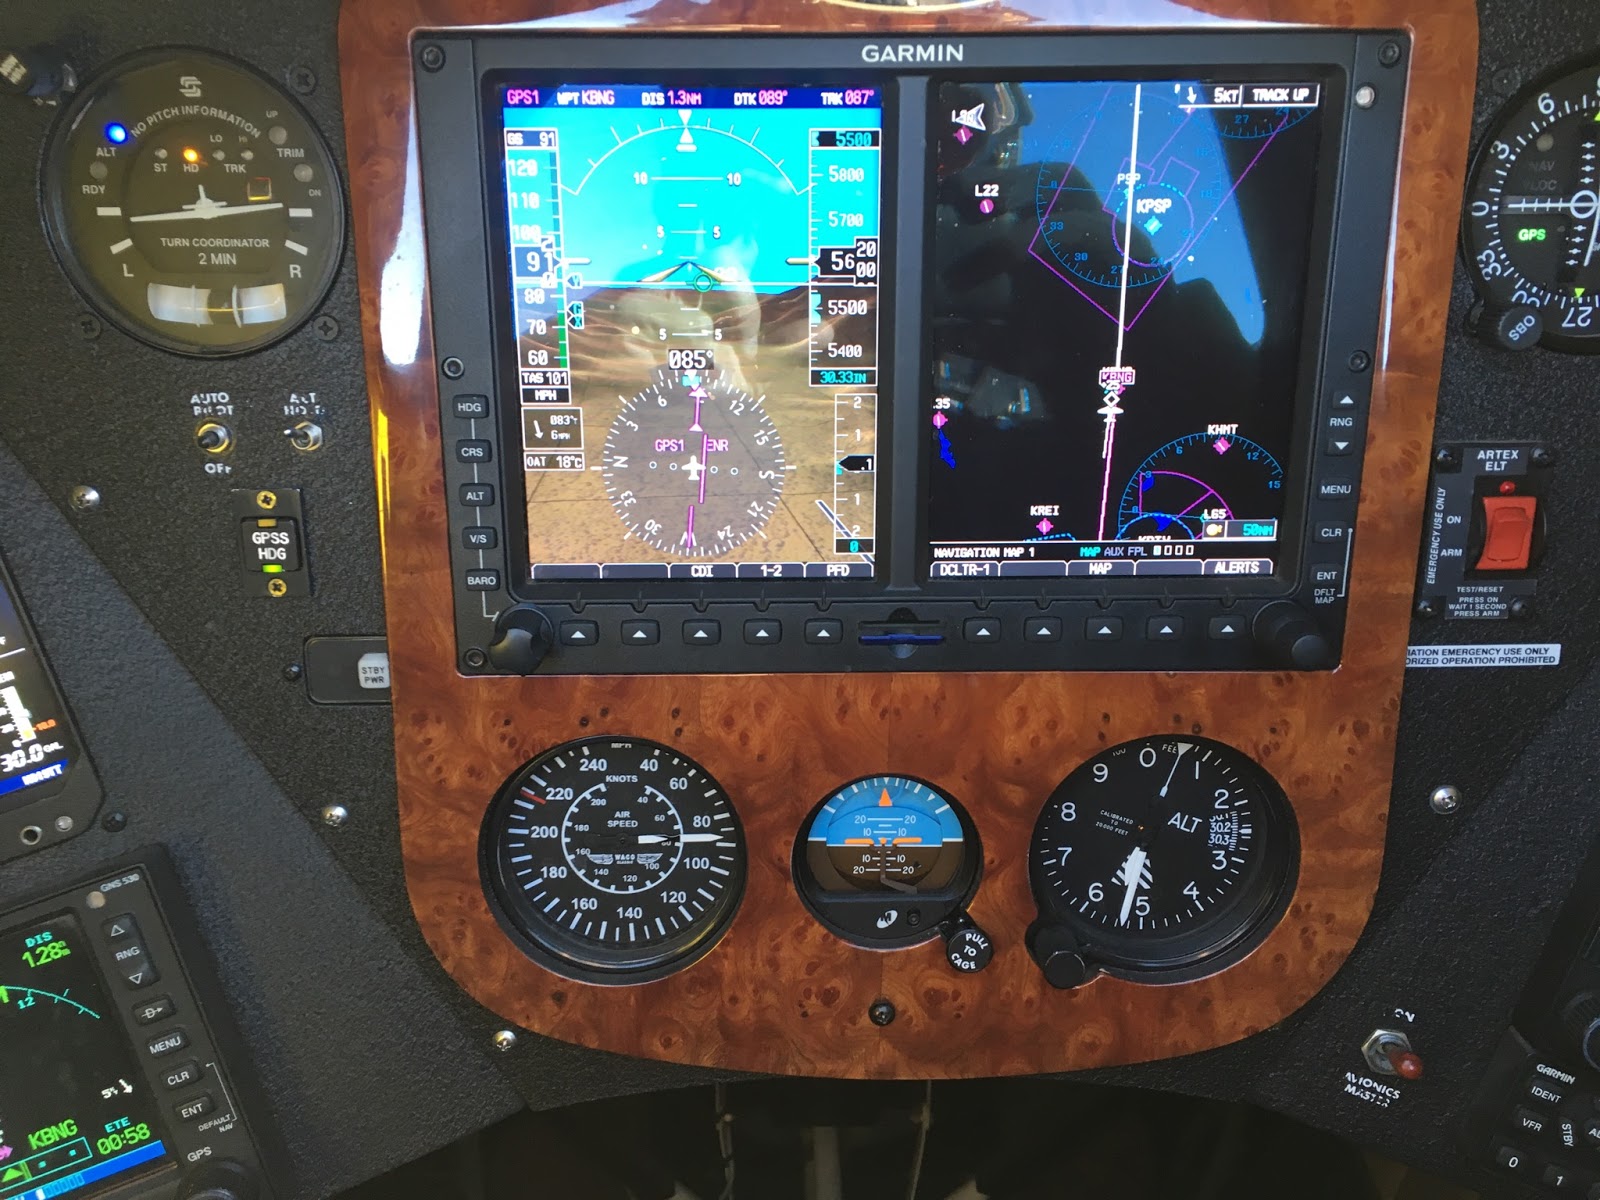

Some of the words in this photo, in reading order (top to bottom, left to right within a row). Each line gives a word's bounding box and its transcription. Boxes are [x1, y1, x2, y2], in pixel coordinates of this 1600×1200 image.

[861, 43, 964, 62] GARMIN
[507, 90, 540, 104] GPS1
[557, 92, 580, 105] WPT
[582, 90, 615, 105] KBNG
[642, 92, 664, 105] DIS
[734, 92, 757, 105] DTK
[821, 92, 843, 105] TRK
[1252, 88, 1289, 102] TRACK
[1293, 88, 1310, 101] UP
[131, 121, 147, 138] NO
[146, 107, 180, 128] PITCH
[181, 105, 261, 138] INFORMATION
[507, 132, 524, 145] GS
[539, 132, 555, 146] 91
[836, 131, 872, 147] 5500
[96, 148, 117, 157] ALT
[277, 148, 304, 158] TRIM
[224, 163, 247, 173] TRK
[508, 159, 538, 177] 120
[829, 165, 864, 182] 5800
[633, 172, 648, 185] 10
[727, 172, 742, 186] 10
[82, 184, 106, 195] RDY
[975, 184, 999, 197] L22
[510, 192, 540, 209] 110
[1136, 199, 1172, 214] KPSP
[828, 211, 864, 227] 5700
[1518, 229, 1546, 241] GPS
[160, 237, 190, 248] TURN
[192, 237, 270, 248] COORDINATOR
[198, 252, 208, 265] 2
[211, 252, 237, 265] MIN
[1476, 248, 1502, 282] 33
[828, 300, 867, 315] 5500
[1562, 306, 1593, 328] 27
[1508, 315, 1535, 341] OBS
[828, 342, 863, 358] 5400
[528, 350, 549, 366] 60
[522, 372, 544, 384] TAS
[546, 372, 568, 385] 101
[190, 392, 230, 404] AUTO
[534, 390, 557, 401] MPH
[457, 403, 482, 412] HDG
[1330, 417, 1353, 427] RNG
[1208, 424, 1238, 435] KHMT
[461, 447, 483, 457] CRS
[655, 439, 685, 452] GPS1
[707, 439, 729, 452] ENR
[526, 456, 547, 467] OAT
[1477, 450, 1519, 460] ARTEX
[1485, 461, 1508, 471] ELT
[1321, 485, 1351, 494] MENU
[466, 492, 484, 501] ALT
[1436, 487, 1446, 511] ONLY
[1030, 505, 1060, 516] KREI
[1204, 508, 1226, 519] L65
[1433, 512, 1443, 530] USE
[1447, 515, 1461, 524] ON
[252, 532, 290, 544] GPSS
[470, 534, 487, 543] V/S
[1321, 528, 1342, 537] CLR
[258, 547, 286, 560] HDG
[934, 547, 1000, 558] NAVIGATION
[1003, 547, 1025, 558] MAP
[1029, 547, 1035, 557] 1
[1080, 546, 1101, 557] MAP
[1104, 546, 1124, 557] AUX
[1128, 546, 1147, 557] FPL
[1426, 531, 1441, 585] EMERGENCY
[1441, 549, 1463, 557] ARM
[691, 565, 714, 577] CDI
[760, 564, 783, 577] 1-2
[827, 564, 850, 576] PFD
[940, 564, 990, 576] DCLTR-1
[1089, 563, 1112, 575] MAP
[1215, 562, 1259, 574] ALERTS
[467, 576, 497, 585] BARO
[1317, 571, 1337, 580] ENT
[1314, 589, 1336, 597] DFLT
[1315, 596, 1335, 604] MAP
[1442, 648, 1502, 656] EMERGENCY
[1524, 647, 1550, 656] ONLY
[1441, 656, 1496, 665] OPERATION
[1498, 656, 1556, 665] PROHIBITED
[362, 666, 385, 675] STBY
[364, 676, 384, 685] PWR
[580, 759, 607, 772] 240
[639, 759, 659, 772] 40
[605, 774, 638, 783] KNOTS
[669, 777, 688, 790] 60
[546, 788, 573, 801] 220
[590, 798, 607, 806] 200
[614, 811, 631, 819] AIR
[693, 815, 711, 828] 80
[1100, 809, 1134, 825] CALIBRATED
[574, 824, 589, 832] 180
[607, 820, 638, 828] SPEED
[1167, 812, 1202, 833] ALT
[1209, 822, 1231, 833] 30.2
[530, 826, 558, 838] 200
[1115, 827, 1128, 836] FEET
[1208, 834, 1230, 845] 30.3
[683, 857, 710, 870] 100
[540, 866, 567, 879] 180
[101, 878, 121, 892] GNS
[571, 898, 598, 910] 160
[660, 891, 687, 904] 120
[616, 907, 643, 919] 140
[25, 931, 53, 948] DIS
[965, 933, 989, 950] PULL
[115, 946, 140, 962] RNG
[963, 945, 976, 957] TO
[951, 953, 976, 970] CAGE
[149, 1036, 182, 1055] MENU
[167, 1070, 190, 1086] CLR
[1536, 1063, 1576, 1085] GARMIN
[1345, 1071, 1401, 1099] AVIONICS
[1531, 1085, 1561, 1103] IDENT
[181, 1103, 203, 1118] ENT
[104, 1116, 131, 1133] ETE
[198, 1113, 231, 1132] DEFAULT
[219, 1122, 234, 1134] NAV
[1522, 1117, 1543, 1132] VFR
[28, 1118, 78, 1150] KBNG
[96, 1123, 150, 1155] 00:58
[1561, 1123, 1574, 1147] STBY
[187, 1146, 212, 1162] GPS
